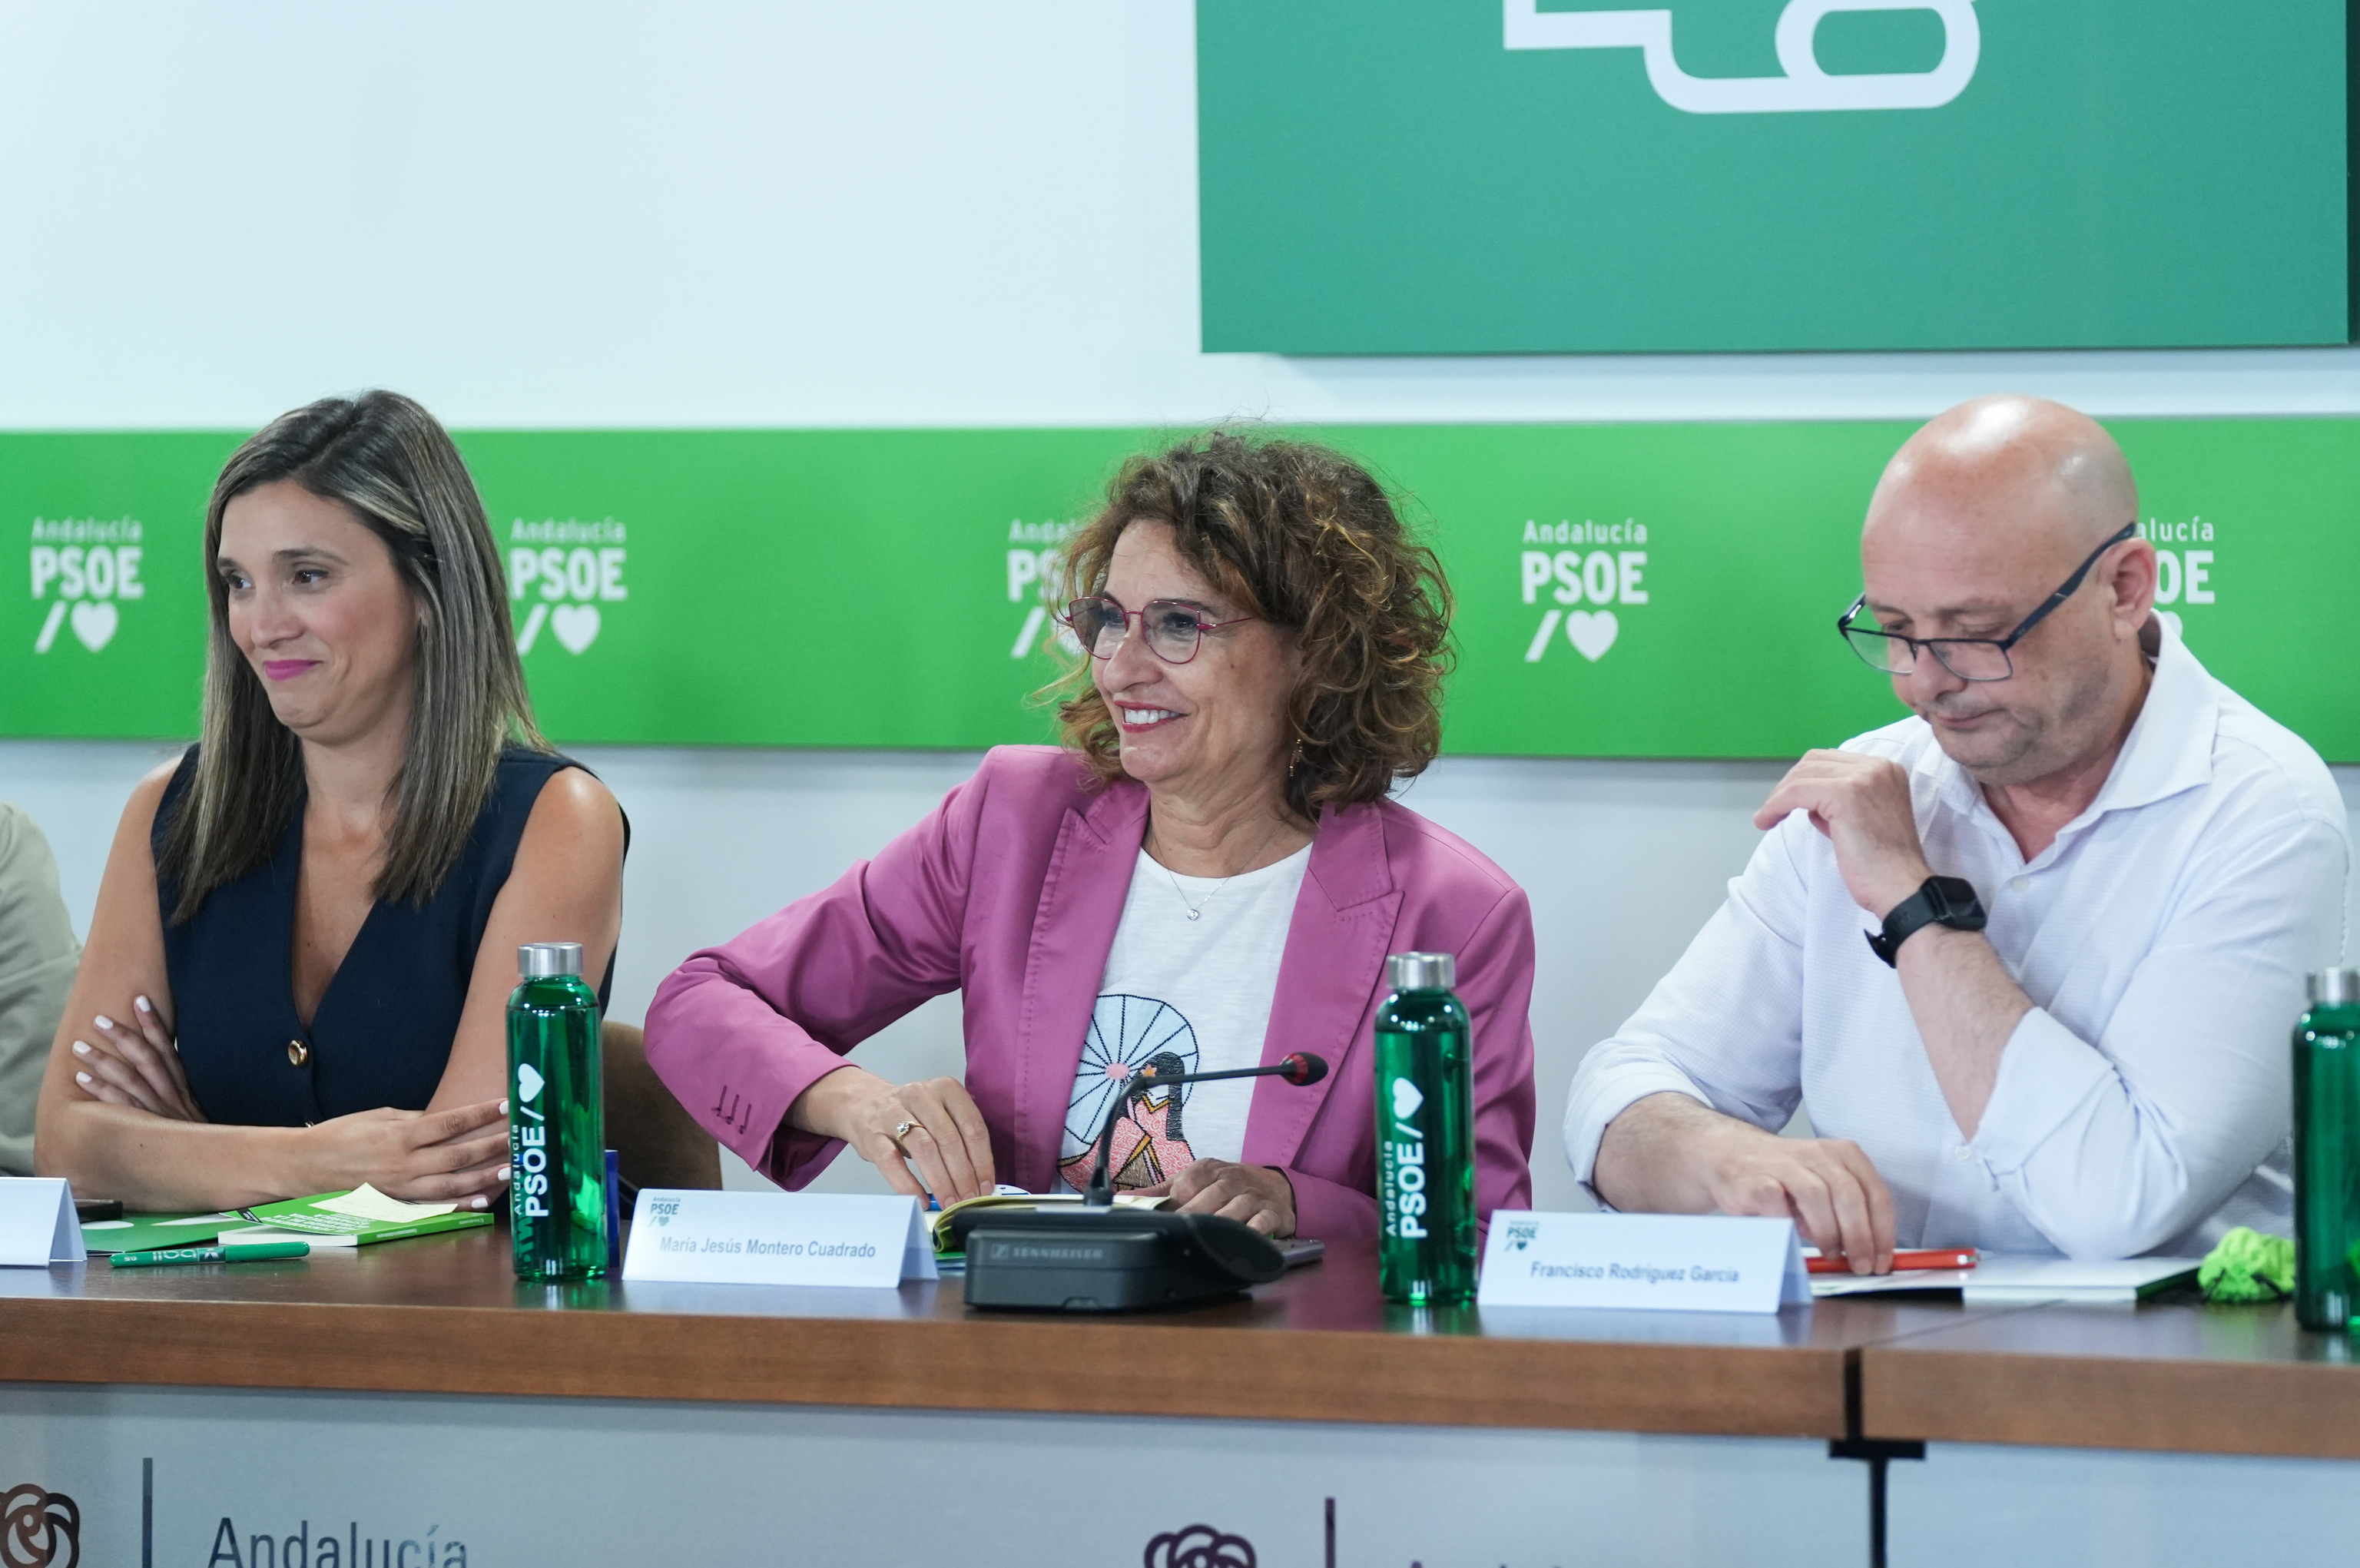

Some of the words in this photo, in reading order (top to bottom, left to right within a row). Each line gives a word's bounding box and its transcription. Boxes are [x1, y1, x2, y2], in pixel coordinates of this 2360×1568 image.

[31, 515, 143, 542] Andalucía
[512, 516, 625, 542] Andalucía
[1523, 518, 1648, 544] Andalucía
[2136, 515, 2214, 542] alucía
[31, 546, 144, 599] PSOE
[510, 549, 627, 600] PSOE
[1008, 550, 1072, 601] PS
[1521, 551, 1649, 605] PSOE
[2154, 549, 2215, 604] OE
[650, 1203, 679, 1215] PSOE
[659, 1236, 696, 1252] María
[701, 1238, 741, 1253] Jesús
[746, 1239, 803, 1255] Montero
[808, 1241, 876, 1258] Cuadrado
[1530, 1261, 1603, 1278] Francisco
[208, 1517, 467, 1568] Andalucía
